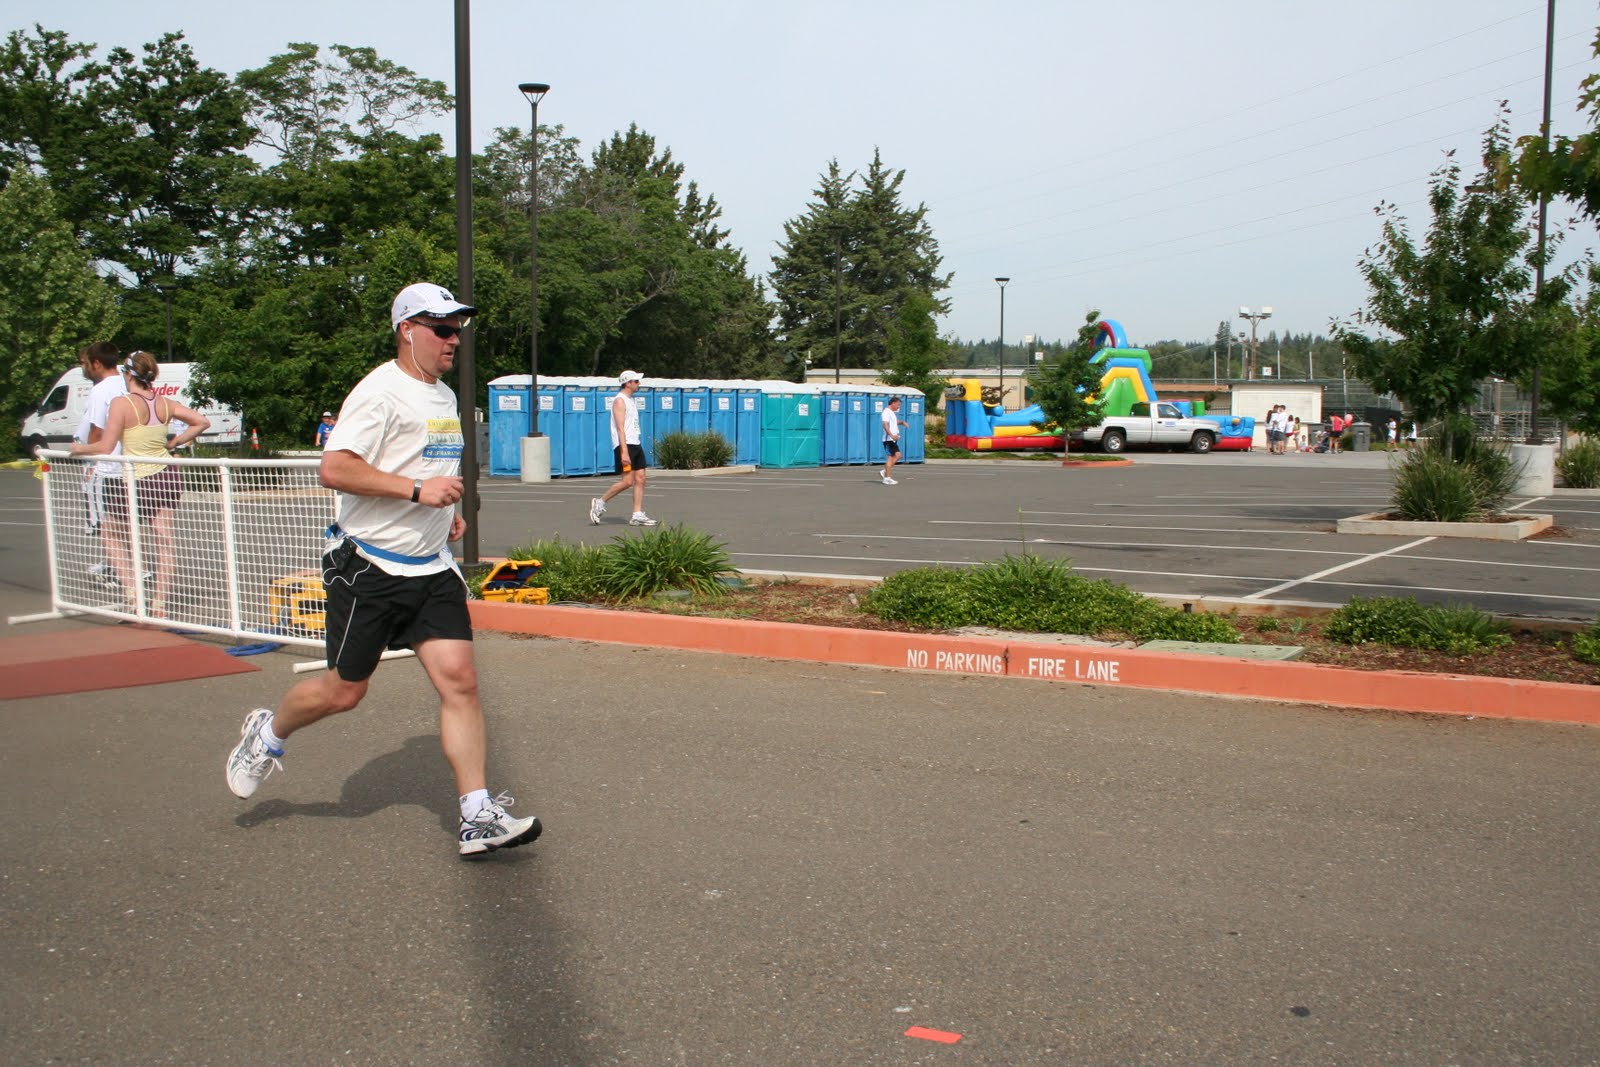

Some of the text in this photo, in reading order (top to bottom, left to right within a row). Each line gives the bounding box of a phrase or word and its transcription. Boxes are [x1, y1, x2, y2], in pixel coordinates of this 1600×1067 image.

[150, 383, 180, 398] yder
[907, 649, 1120, 682] NO PARKING FIRE LANE
